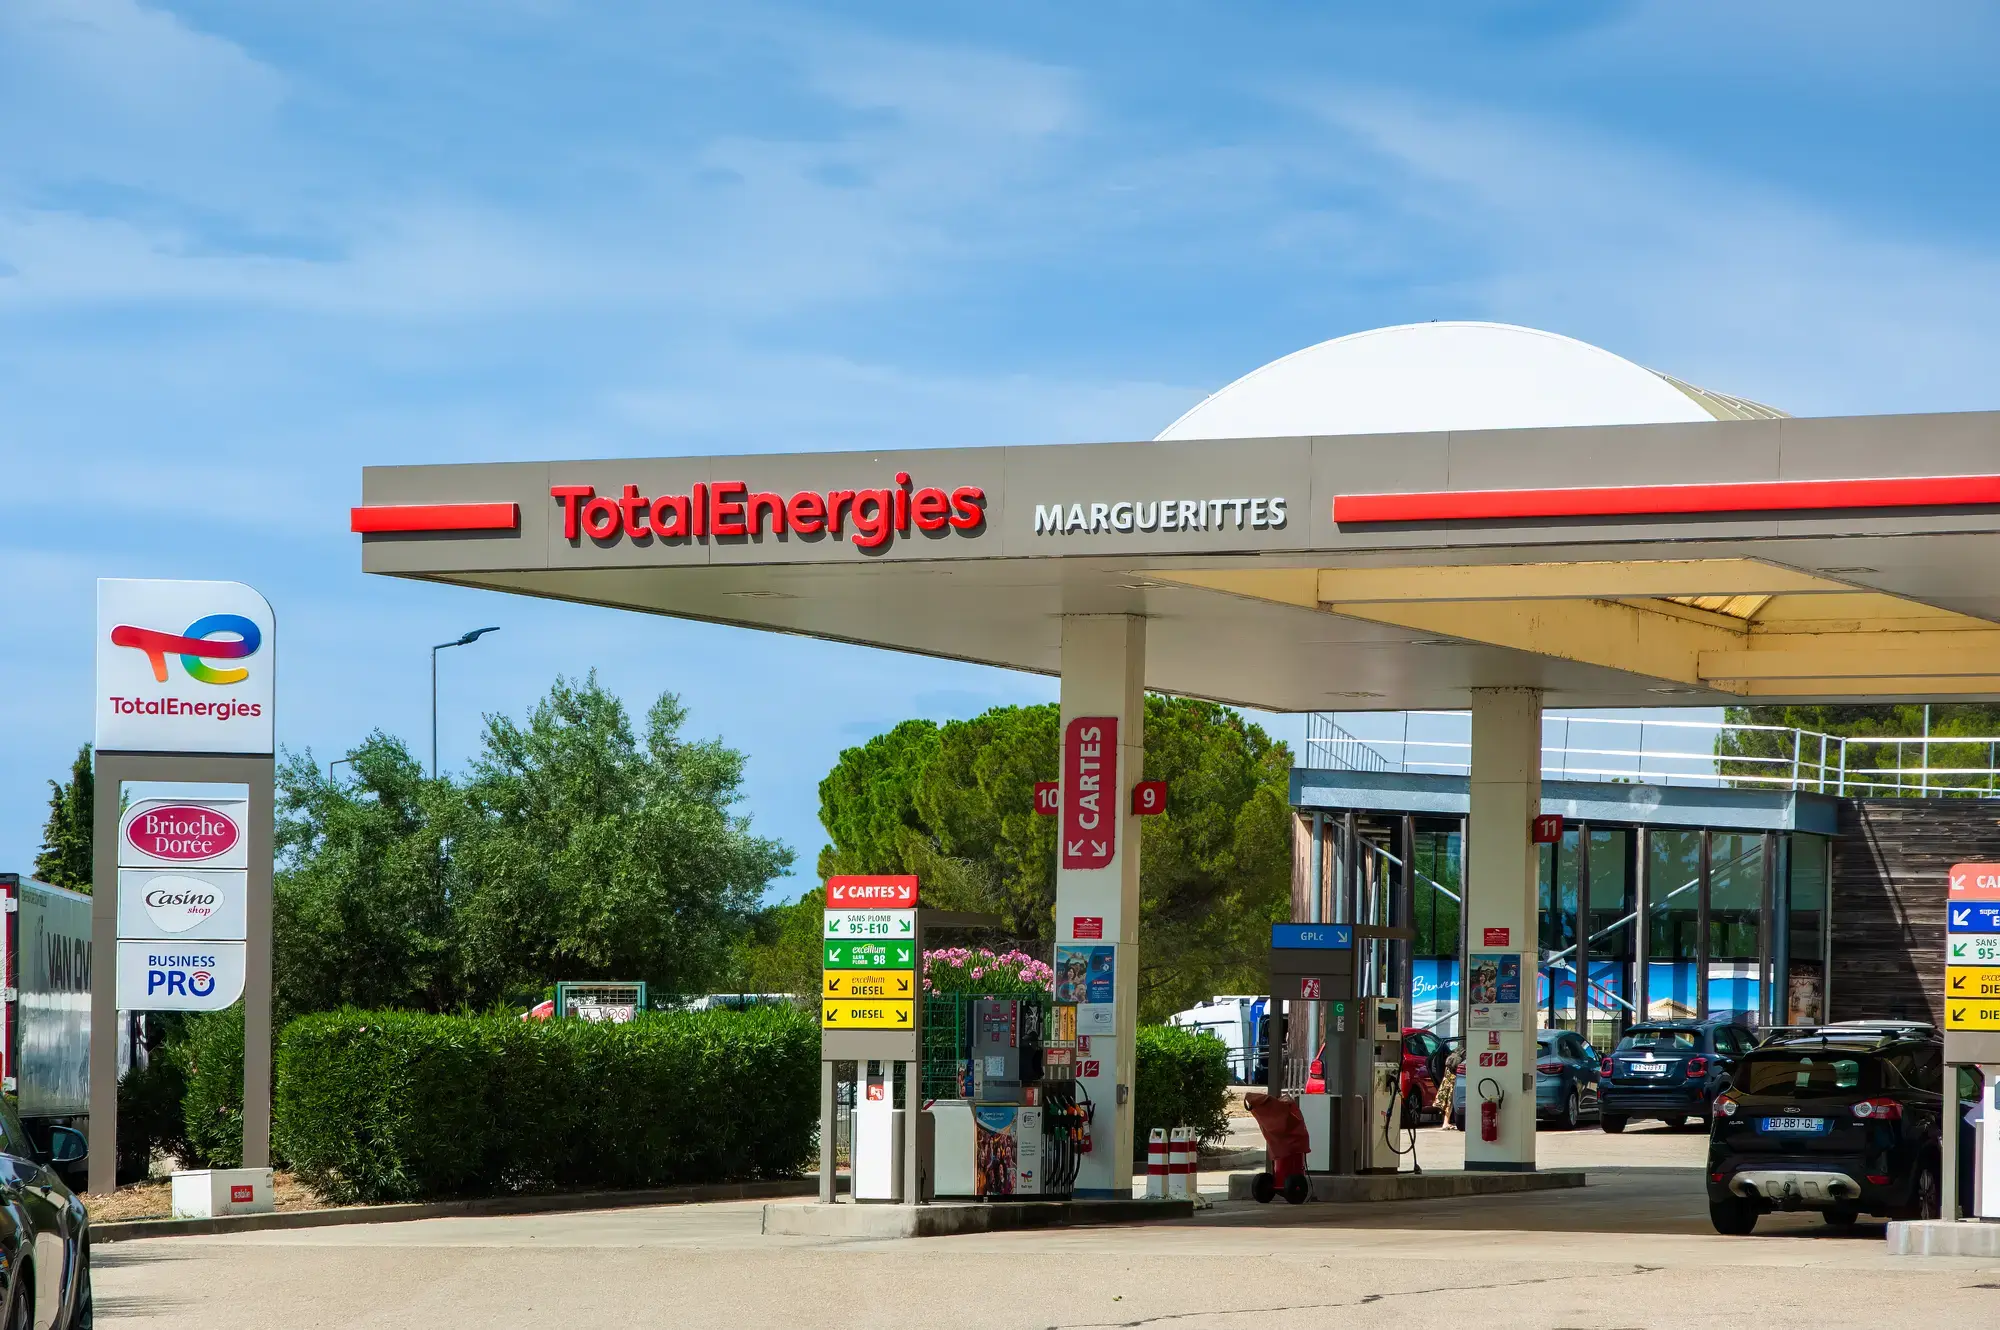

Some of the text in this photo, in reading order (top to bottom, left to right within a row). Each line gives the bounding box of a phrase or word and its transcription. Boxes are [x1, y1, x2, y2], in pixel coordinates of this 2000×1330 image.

[551, 471, 986, 548] TotalEnergies
[1034, 497, 1286, 534] MARGUERITTES
[109, 696, 262, 721] TotalEnergies
[1079, 726, 1102, 830] CARTES
[1038, 788, 1059, 808] 10
[1143, 788, 1156, 808] 9
[144, 814, 225, 836] Brioche
[1540, 819, 1557, 837] 11
[154, 834, 213, 854] Dorée
[1976, 875, 2000, 889] CA
[145, 889, 215, 908] Casino
[848, 886, 895, 899] CARTES
[187, 905, 211, 917] shop
[847, 914, 892, 922] SANS PLOMB
[849, 923, 889, 935] 95-E10
[1300, 931, 1324, 941] GPLc
[852, 943, 886, 954] excellium
[1975, 938, 1998, 947] SANS
[47, 931, 72, 991] VAN
[148, 955, 216, 968] BUSINESS
[873, 954, 886, 965] 98
[147, 970, 216, 998] PRO
[851, 975, 885, 984] excellium
[851, 986, 885, 995] DIESEL
[851, 1009, 885, 1019] DIESEL
